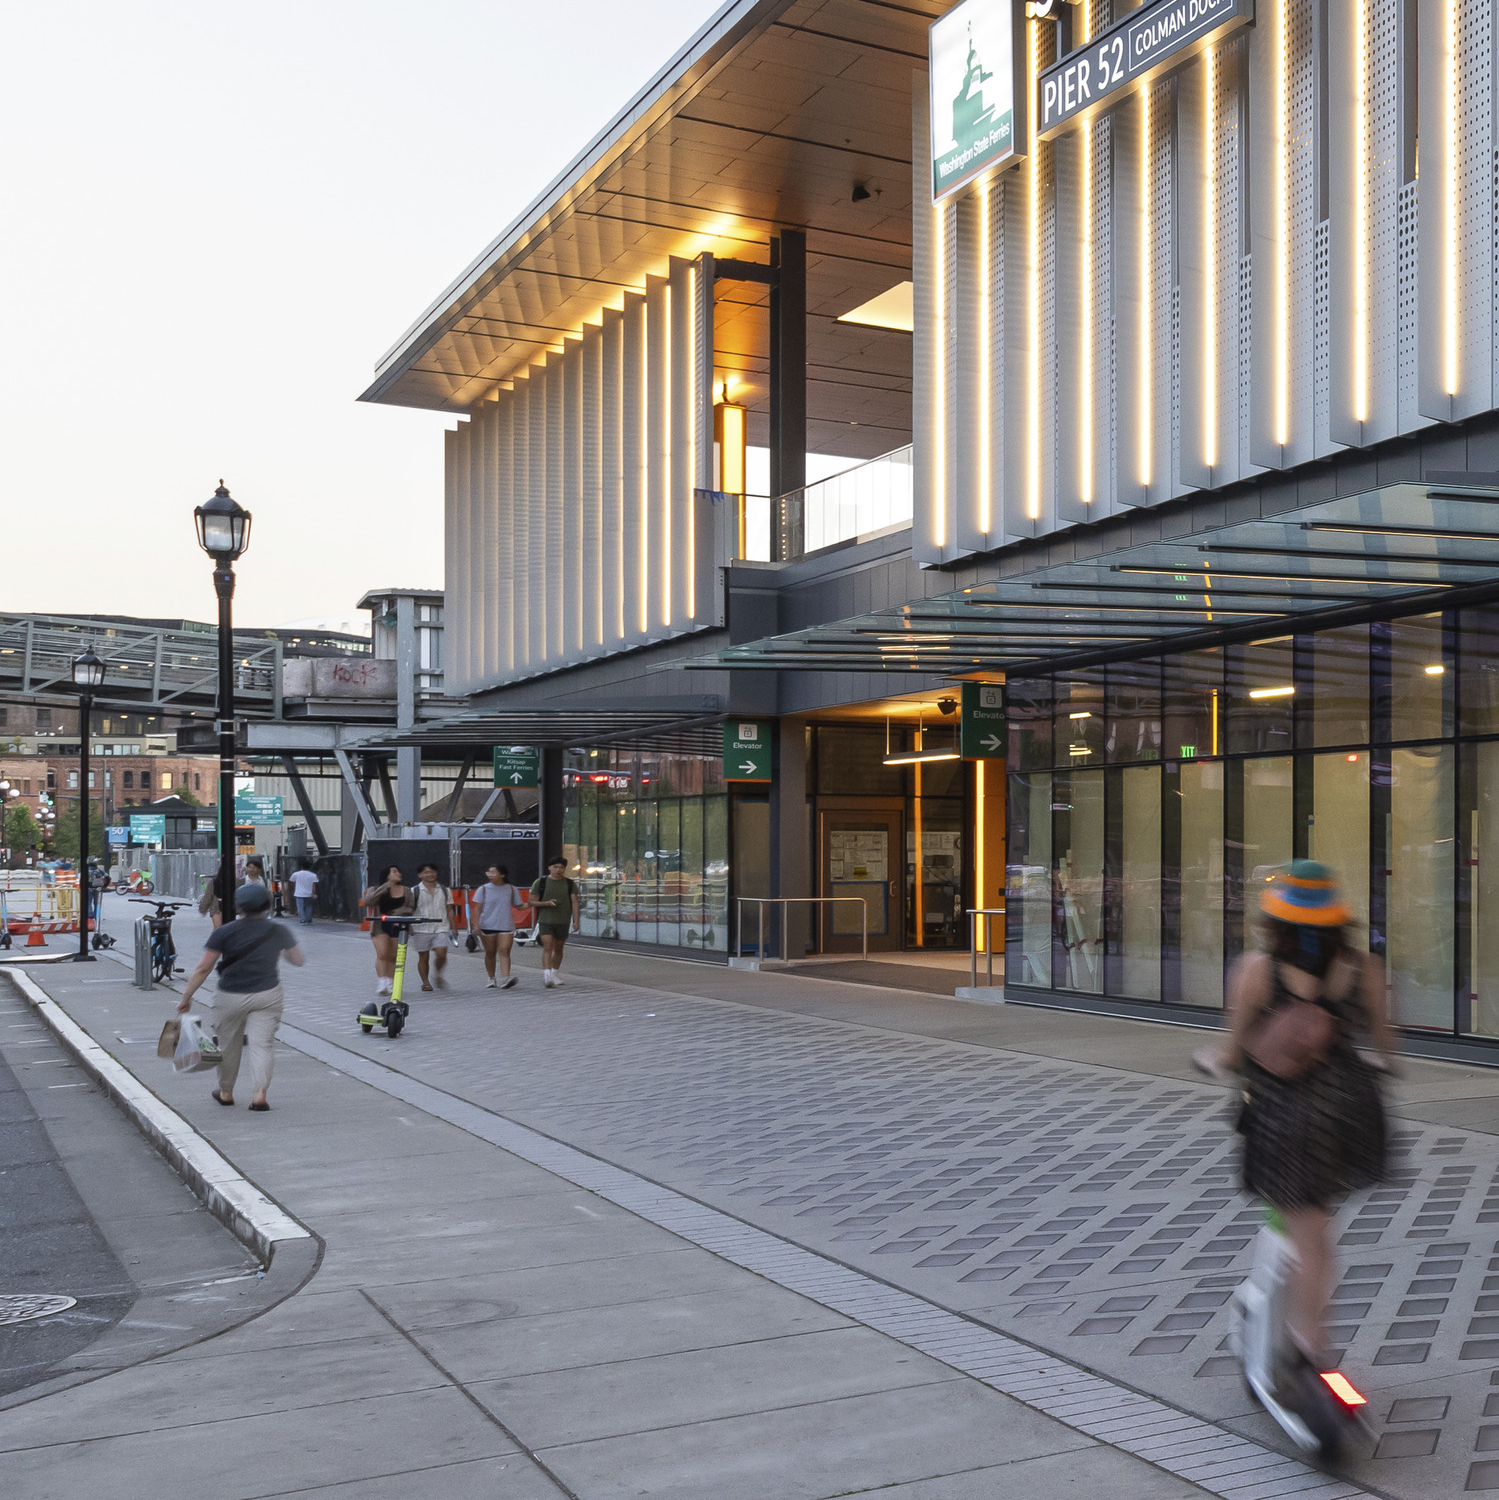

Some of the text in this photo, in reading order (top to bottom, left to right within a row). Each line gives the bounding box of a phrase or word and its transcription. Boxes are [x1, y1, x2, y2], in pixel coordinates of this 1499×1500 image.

[1044, 59, 1091, 124] PIER
[1097, 36, 1124, 90] 52
[1135, 5, 1186, 56] COLMAN
[939, 122, 1010, 179] Washington State Ferries
[973, 710, 1005, 720] Elevato
[733, 742, 763, 750] Elevator
[1181, 745, 1195, 758] XIT
